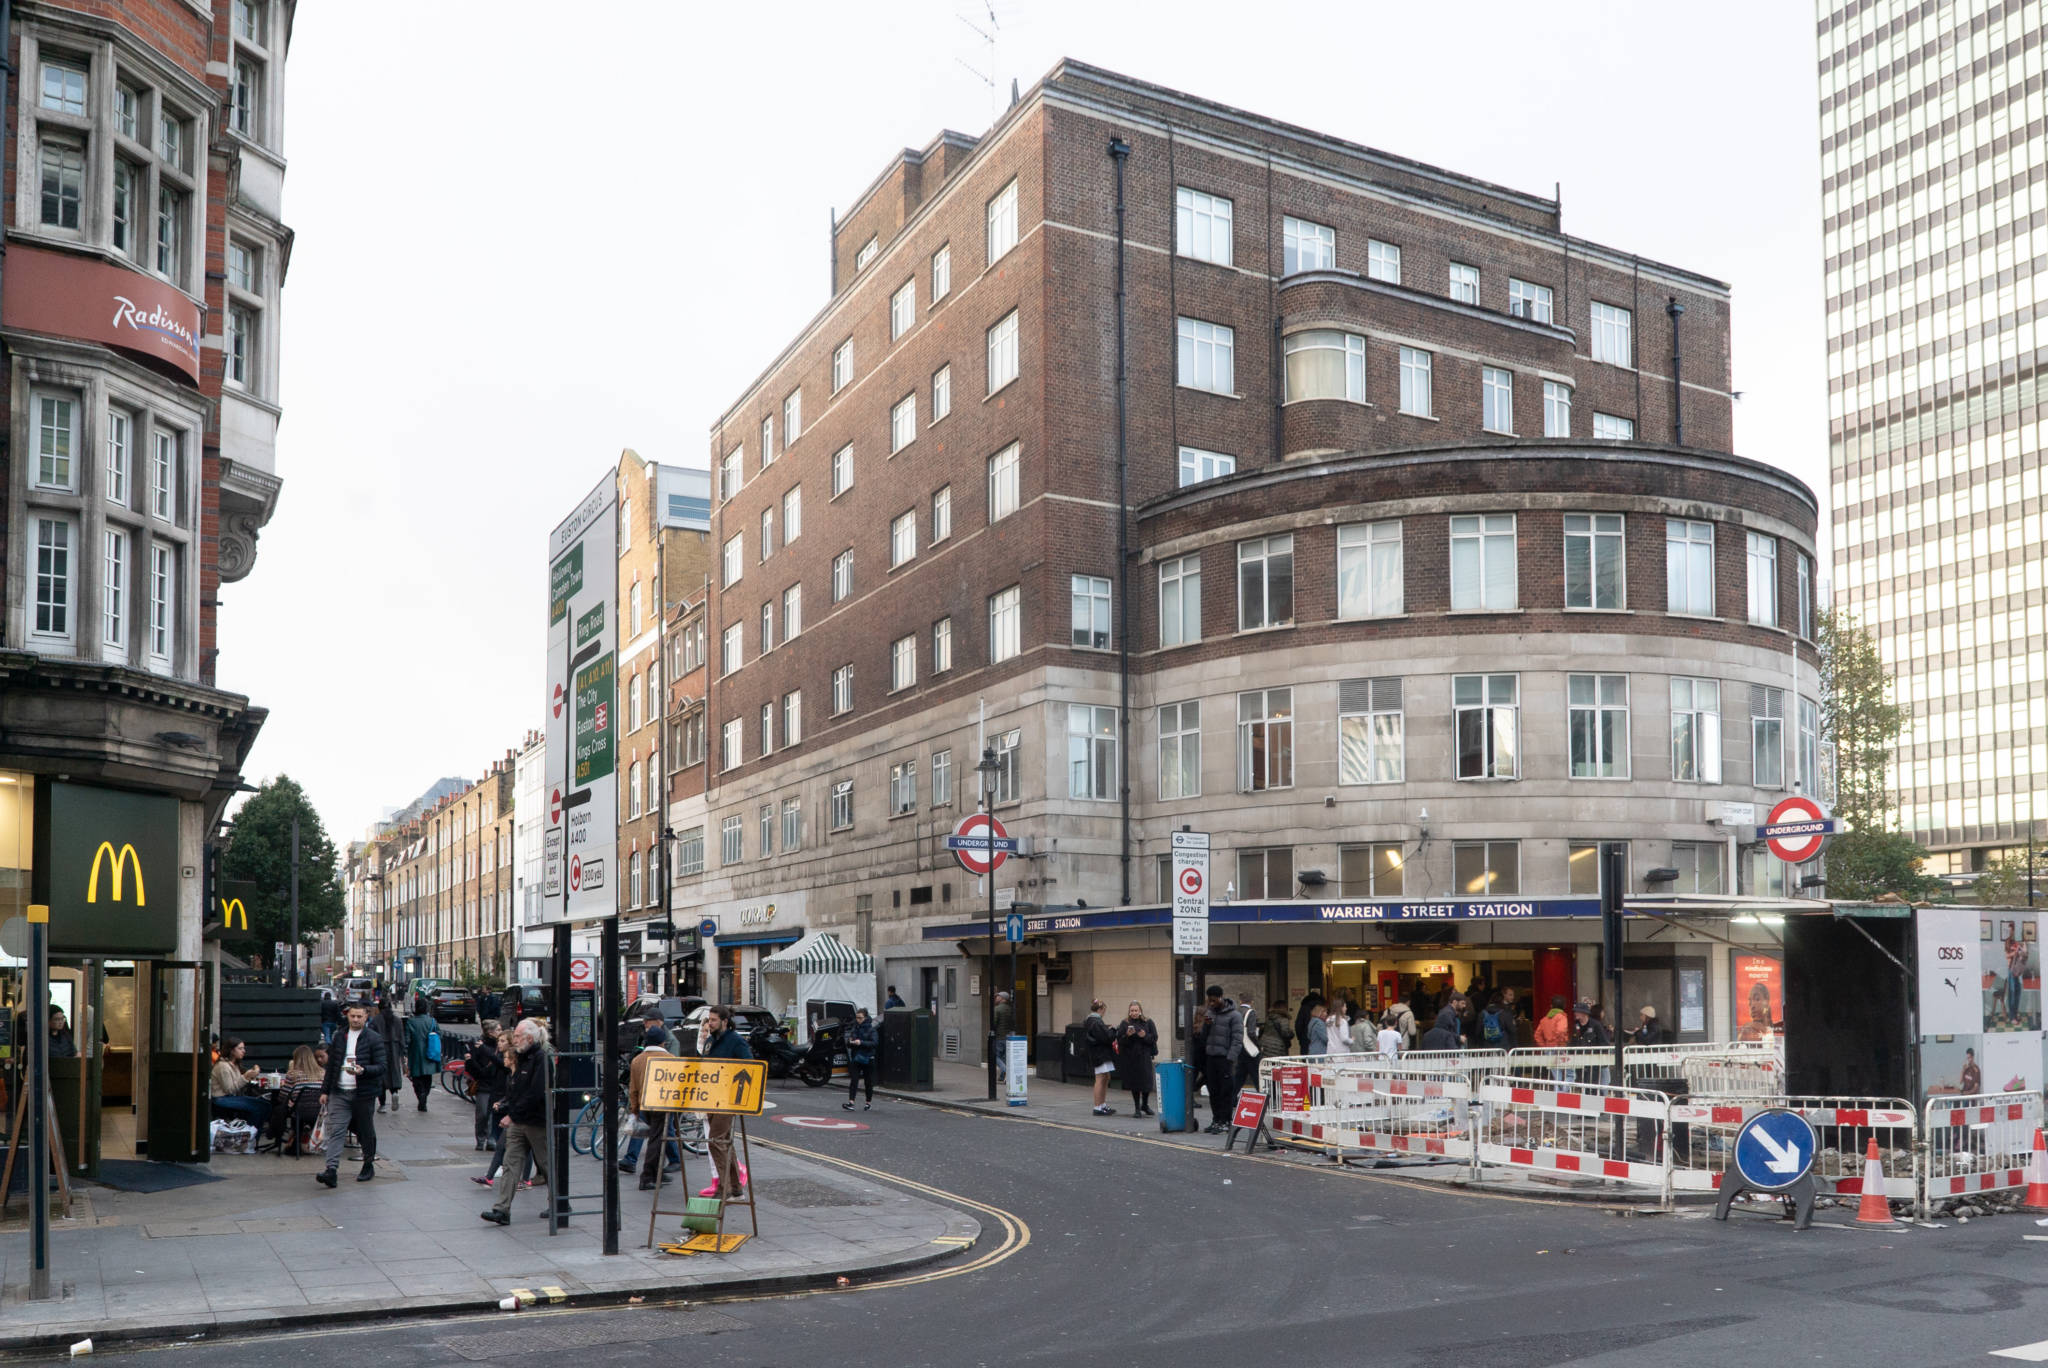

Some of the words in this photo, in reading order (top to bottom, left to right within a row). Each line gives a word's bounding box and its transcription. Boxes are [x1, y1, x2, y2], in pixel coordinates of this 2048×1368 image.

[112, 295, 193, 346] Radisson
[561, 513, 582, 544] EUSTON
[583, 491, 603, 522] CIRCUS
[570, 569, 582, 587] Town
[578, 623, 590, 640] Ring
[590, 608, 603, 630] Road
[577, 695, 587, 709] The
[586, 688, 598, 705] City
[577, 717, 595, 736] Euston
[576, 745, 591, 760] Kings
[591, 737, 607, 754] Cross
[571, 811, 592, 827] Holborn
[1766, 823, 1825, 836] UNDERGROUND
[957, 839, 1009, 848] UNDERGRUND
[1174, 850, 1208, 858] Congestion
[1177, 858, 1204, 866] charging
[1177, 896, 1205, 905] Central
[1180, 905, 1202, 914] ZONE
[1320, 906, 1383, 918] WARREN
[1401, 904, 1455, 917] STREET
[1468, 903, 1533, 917] STATION
[1027, 920, 1048, 931] STREET
[1055, 918, 1081, 929] STATION
[1938, 947, 1964, 960] asos
[654, 1068, 720, 1084] Diverted
[659, 1086, 709, 1103] traffic
